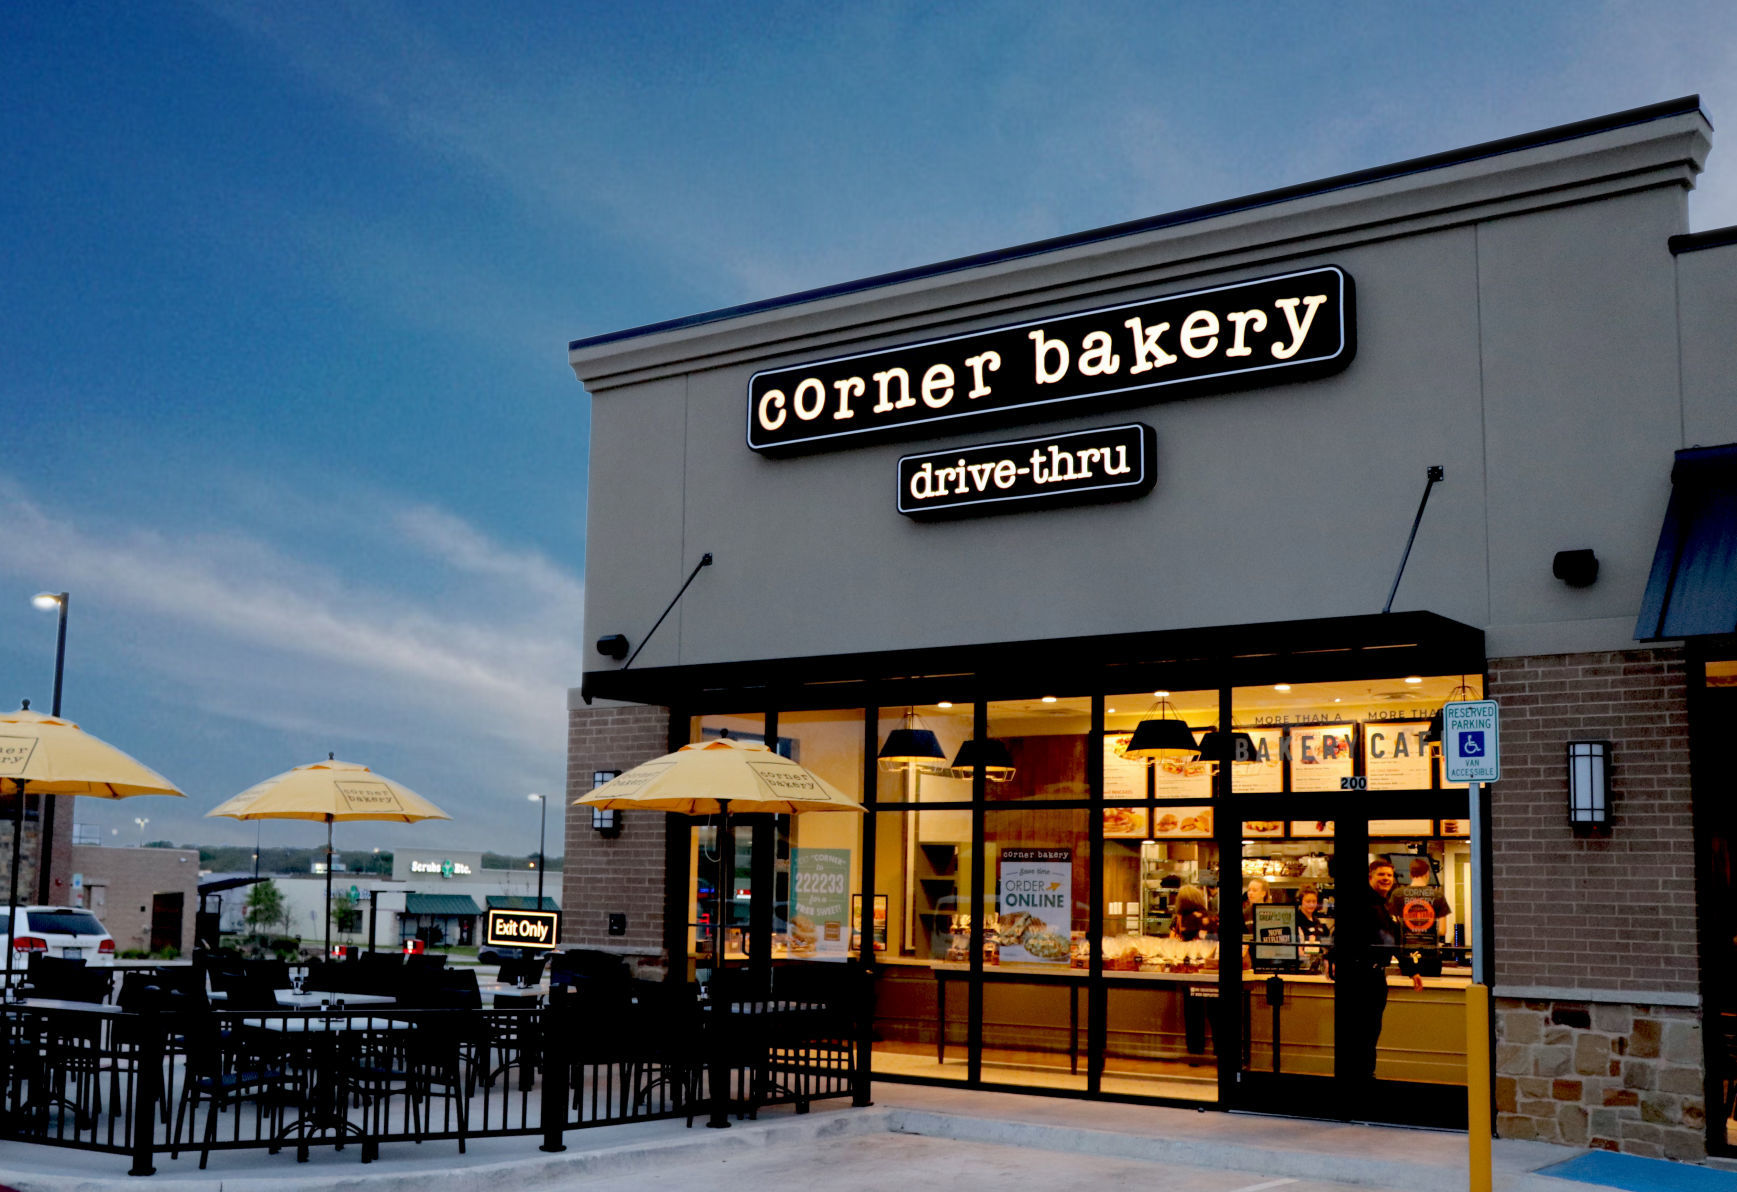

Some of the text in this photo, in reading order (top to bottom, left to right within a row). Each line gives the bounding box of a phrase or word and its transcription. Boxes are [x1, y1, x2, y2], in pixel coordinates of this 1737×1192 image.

[757, 293, 1328, 431] corner bakery
[909, 444, 1131, 500] drive-thru
[1368, 710, 1405, 720] MORE
[1449, 707, 1494, 718] RESERVED
[1255, 713, 1343, 725] MORE THAN A
[1452, 719, 1491, 730] PARKING
[1235, 733, 1358, 763] BAKERY
[760, 770, 809, 781] corner
[1451, 768, 1494, 777] ACCESSIBLE
[768, 779, 815, 790] bakery
[1341, 777, 1366, 789] 200
[348, 795, 392, 804] bakery
[1003, 850, 1069, 860] corner bakery
[411, 861, 441, 873] Scrubs
[795, 872, 844, 894] 222233
[1005, 880, 1045, 892] ORDER
[1403, 888, 1435, 897] CORNER
[1005, 893, 1065, 908] ONLINE
[495, 918, 549, 942] Exit Only
[1268, 928, 1283, 936] NOW
